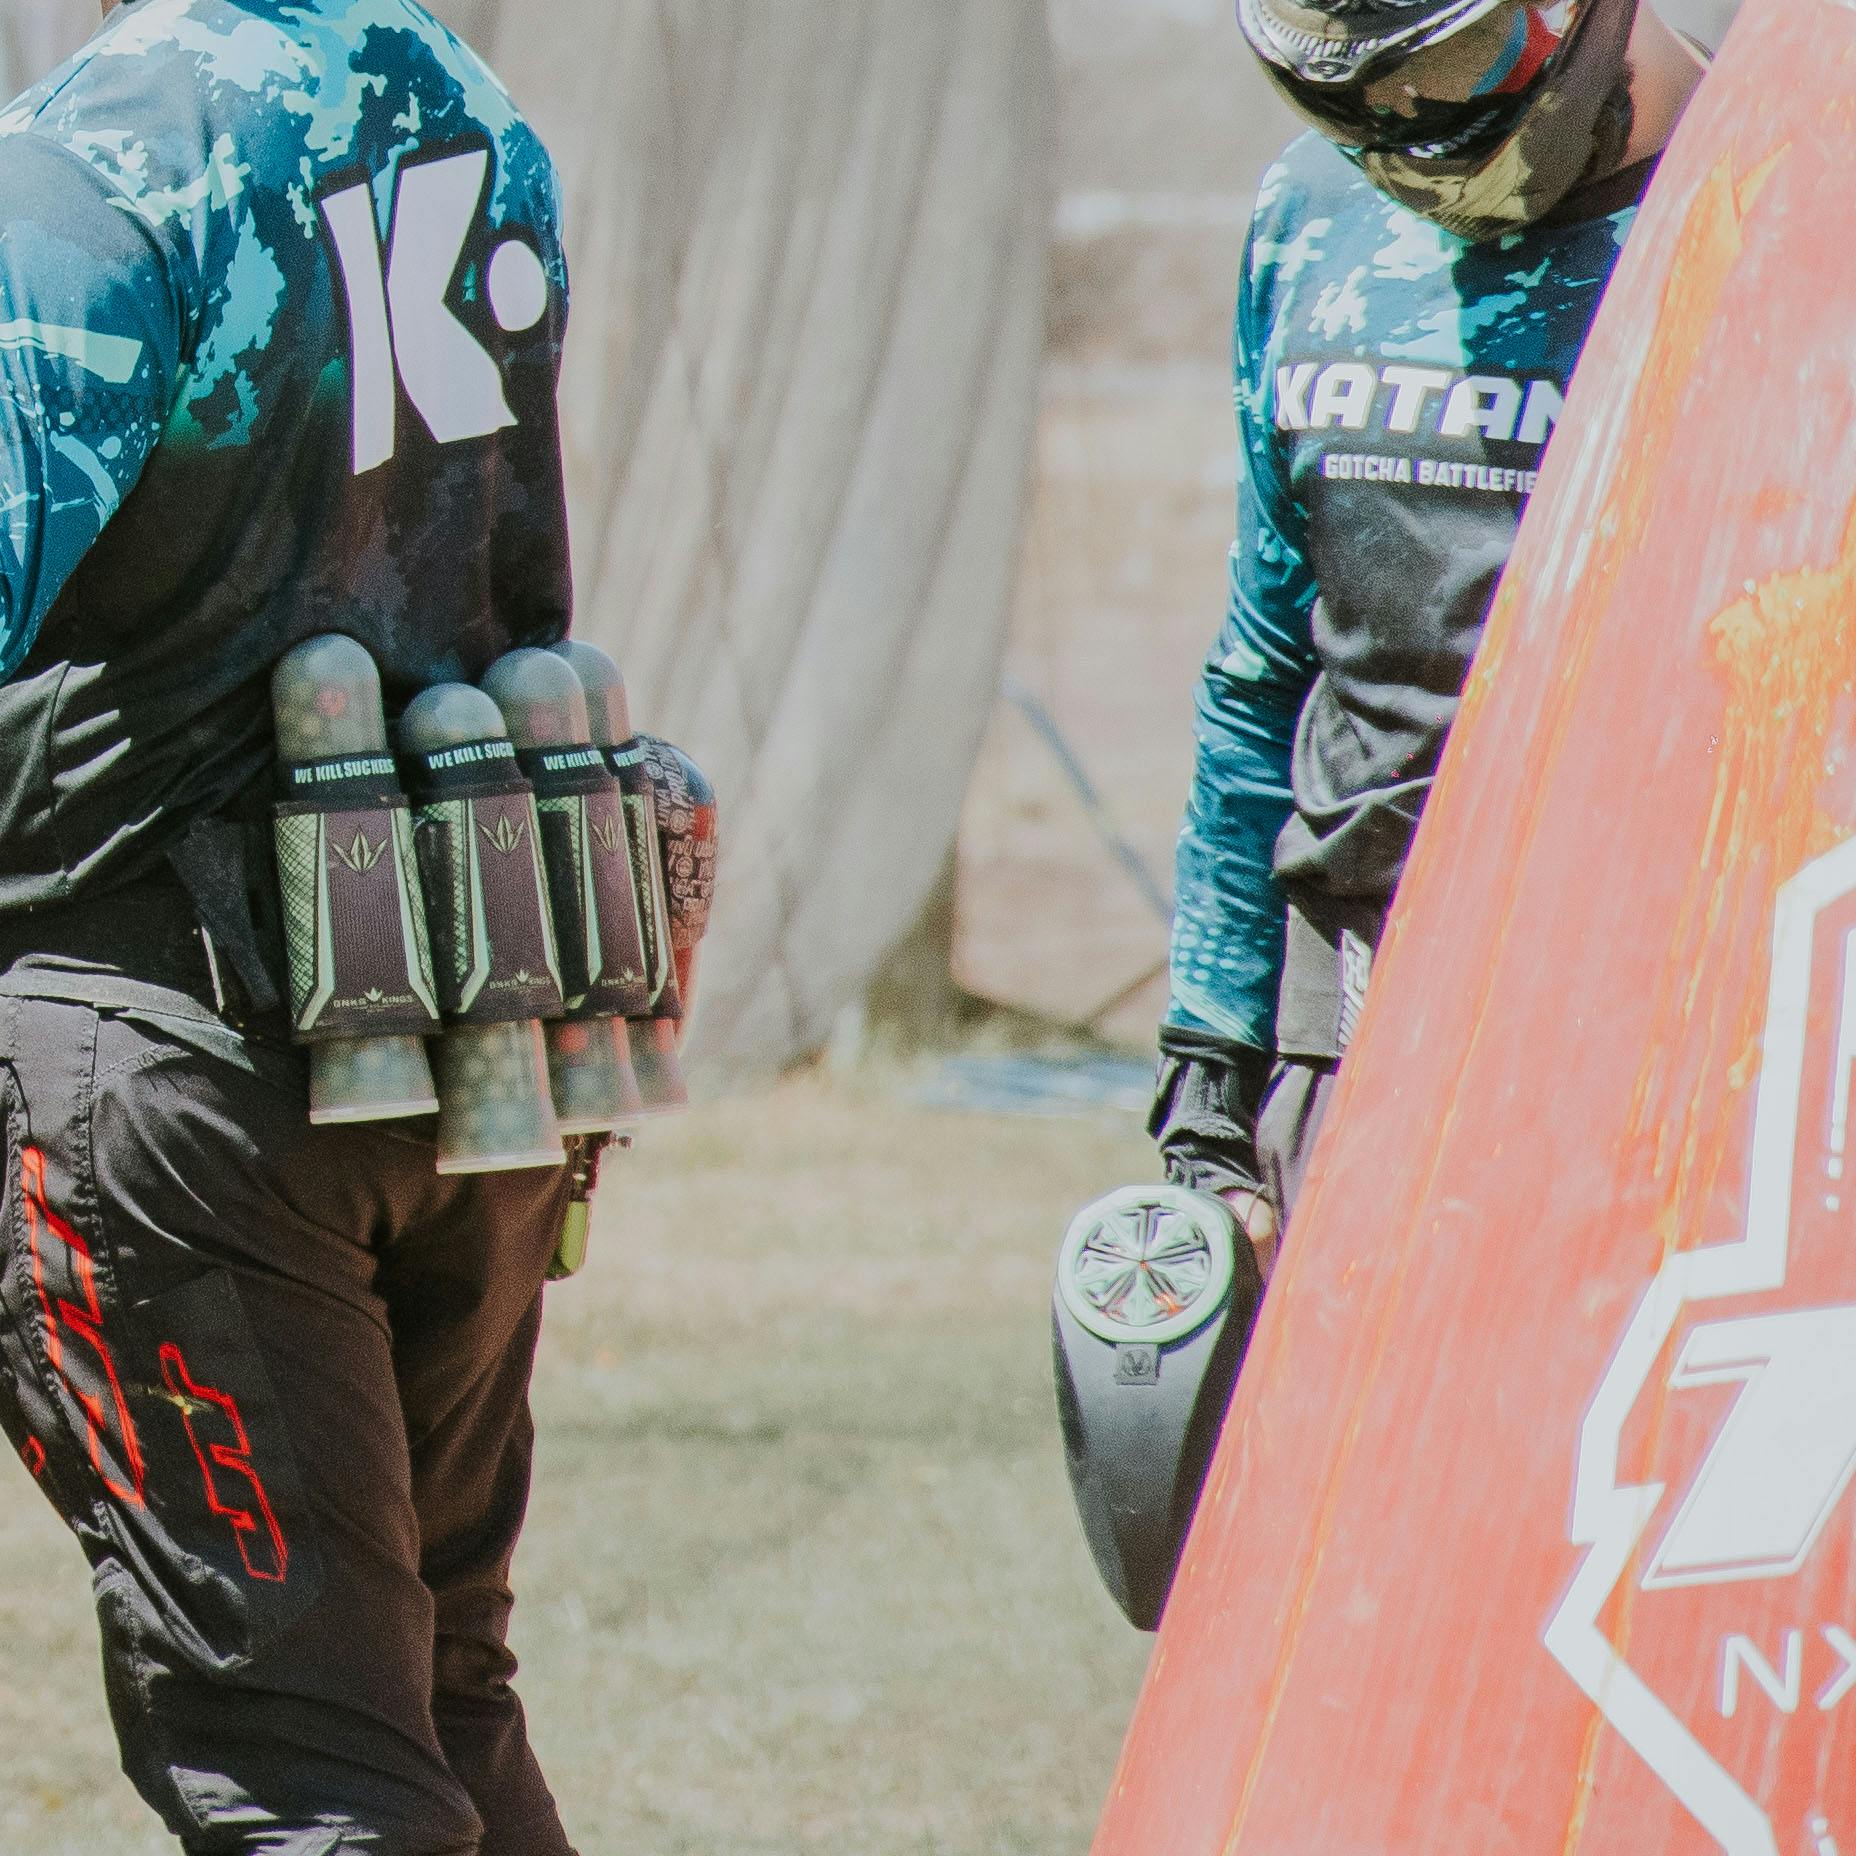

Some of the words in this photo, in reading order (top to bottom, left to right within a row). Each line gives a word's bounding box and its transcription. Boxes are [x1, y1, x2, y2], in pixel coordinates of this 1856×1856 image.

[1322, 453, 1412, 483] GOTCHA
[428, 752, 453, 770] WE
[454, 745, 484, 764] KILL
[543, 754, 566, 771] WE
[294, 767, 313, 784] WE
[316, 763, 344, 782] KILL
